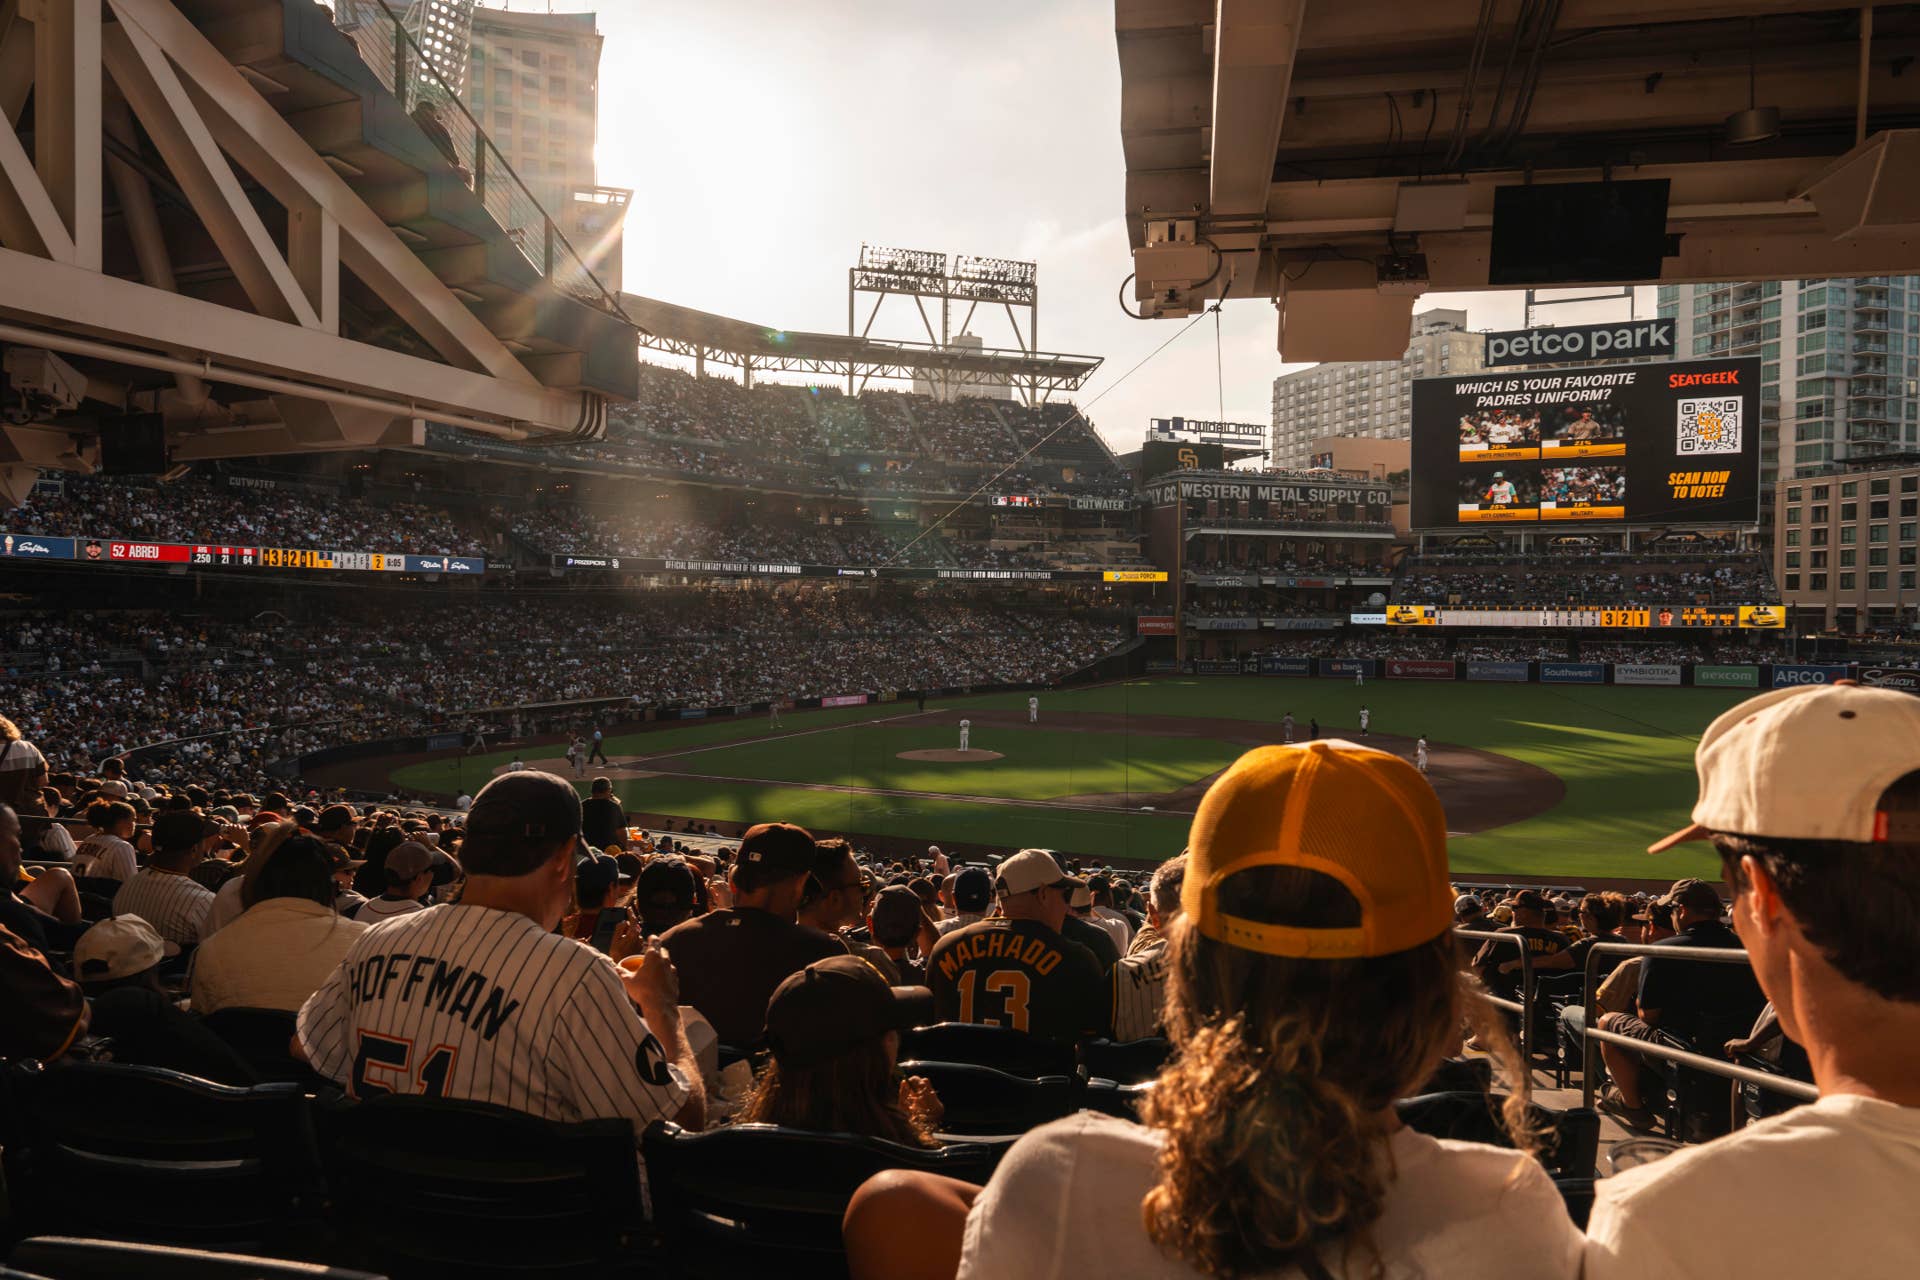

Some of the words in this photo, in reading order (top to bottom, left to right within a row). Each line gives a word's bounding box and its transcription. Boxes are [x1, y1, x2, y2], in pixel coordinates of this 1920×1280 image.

[1488, 331, 1584, 365] petco
[1590, 324, 1671, 356] park
[1455, 380, 1503, 395] WHICH
[1505, 380, 1519, 392] IS
[1523, 377, 1562, 391] YOUR
[1564, 372, 1636, 388] FAVORITE
[1668, 370, 1739, 388] SEATGEEK
[1476, 393, 1532, 408] PADRES
[1534, 388, 1612, 404] UNIFORM?
[229, 477, 276, 489] CUTWATER
[1668, 472, 1700, 485] SCAN
[1701, 470, 1731, 484] NOW
[1181, 482, 1250, 500] WESTERN
[1257, 486, 1304, 502] METAL
[1308, 488, 1362, 504] SUPPLY
[1367, 490, 1390, 505] CO.
[1673, 486, 1689, 499] TO
[1690, 484, 1726, 498] VOTE!
[1077, 499, 1125, 511] CUTWATER
[112, 544, 125, 558] 52
[128, 545, 159, 558] ABREU
[271, 550, 278, 565] 3
[290, 550, 296, 566] 2
[310, 552, 314, 566] 1
[194, 554, 211, 563] .250
[222, 555, 230, 564] 21
[243, 556, 252, 565] 64
[376, 558, 380, 568] 2
[386, 558, 402, 567] 6:05
[666, 561, 686, 570] OFFICIAL
[688, 561, 700, 570] DAILY
[702, 562, 722, 571] FANTASY
[722, 562, 742, 572] PARTNER
[758, 564, 768, 573] SAN
[769, 564, 783, 574] DIEGO
[784, 565, 801, 574] PADRES
[1606, 612, 1612, 625] 3
[1622, 612, 1628, 625] 2
[1639, 612, 1644, 626] 1
[1343, 662, 1362, 671] bank
[1544, 667, 1593, 677] Southwest
[1775, 670, 1825, 684] ARCO
[938, 932, 1063, 982] MACHADO
[350, 954, 520, 1041] HOFFMAN
[957, 968, 1031, 1034] 13
[352, 1028, 458, 1103] 51
